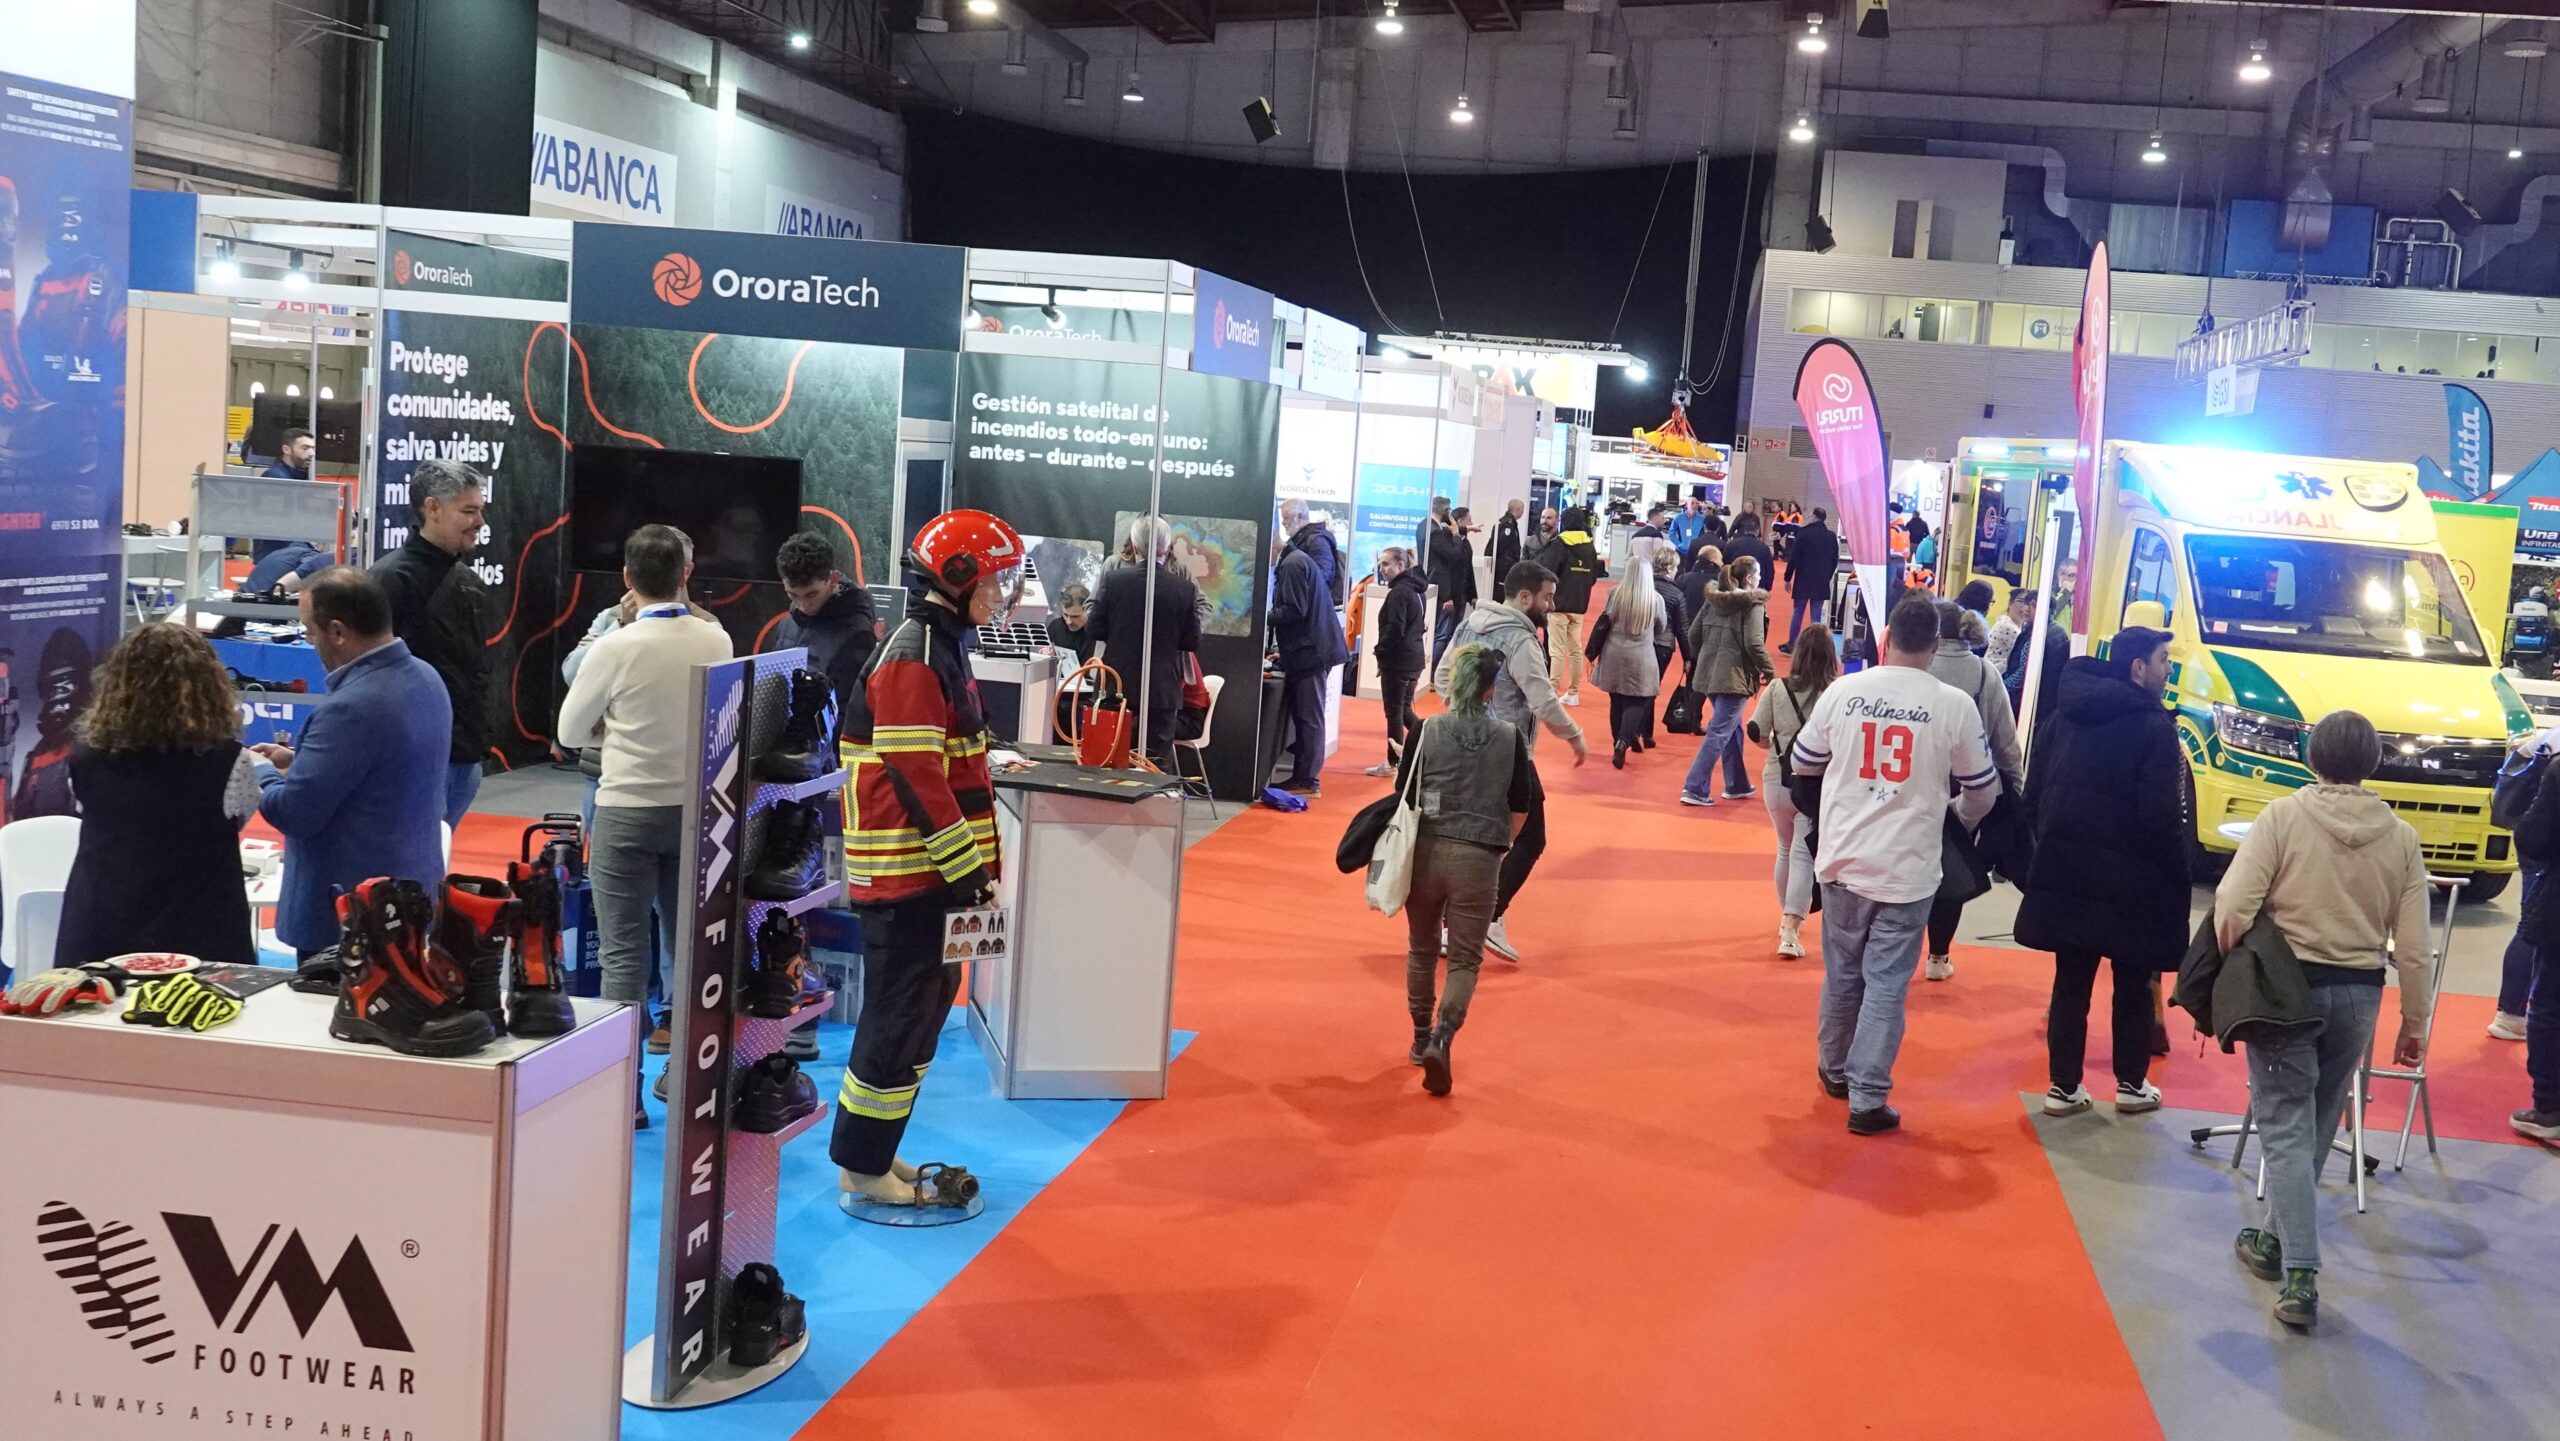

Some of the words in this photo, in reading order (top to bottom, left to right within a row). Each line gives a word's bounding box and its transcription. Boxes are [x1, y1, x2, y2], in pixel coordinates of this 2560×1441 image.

[413, 260, 473, 288] OroraTech
[712, 268, 880, 308] OroraTech
[1226, 313, 1260, 347] OroraTech
[389, 340, 469, 384] Protege
[386, 392, 516, 426] comunidades,
[972, 392, 1051, 415] Gestión
[1056, 400, 1139, 421] satelital
[971, 416, 1069, 441] incendios
[386, 431, 436, 461] salva
[439, 436, 489, 464] vidas
[491, 441, 505, 470] y
[969, 444, 1026, 462] antes
[1046, 447, 1128, 469] durante
[2529, 501, 2560, 512] ma
[2524, 529, 2558, 540] Una
[1845, 696, 1932, 724] Polinesia
[1858, 721, 1914, 783] 13
[585, 961, 600, 970] PRO
[681, 917, 726, 1375] FOOTWEAR
[160, 1211, 416, 1353] VM
[193, 1344, 416, 1395] FOOTWEAR
[54, 1389, 165, 1416] ALWAYS
[190, 1405, 200, 1421] A
[225, 1409, 295, 1432] STEP
[320, 1420, 414, 1441] AHEAD
